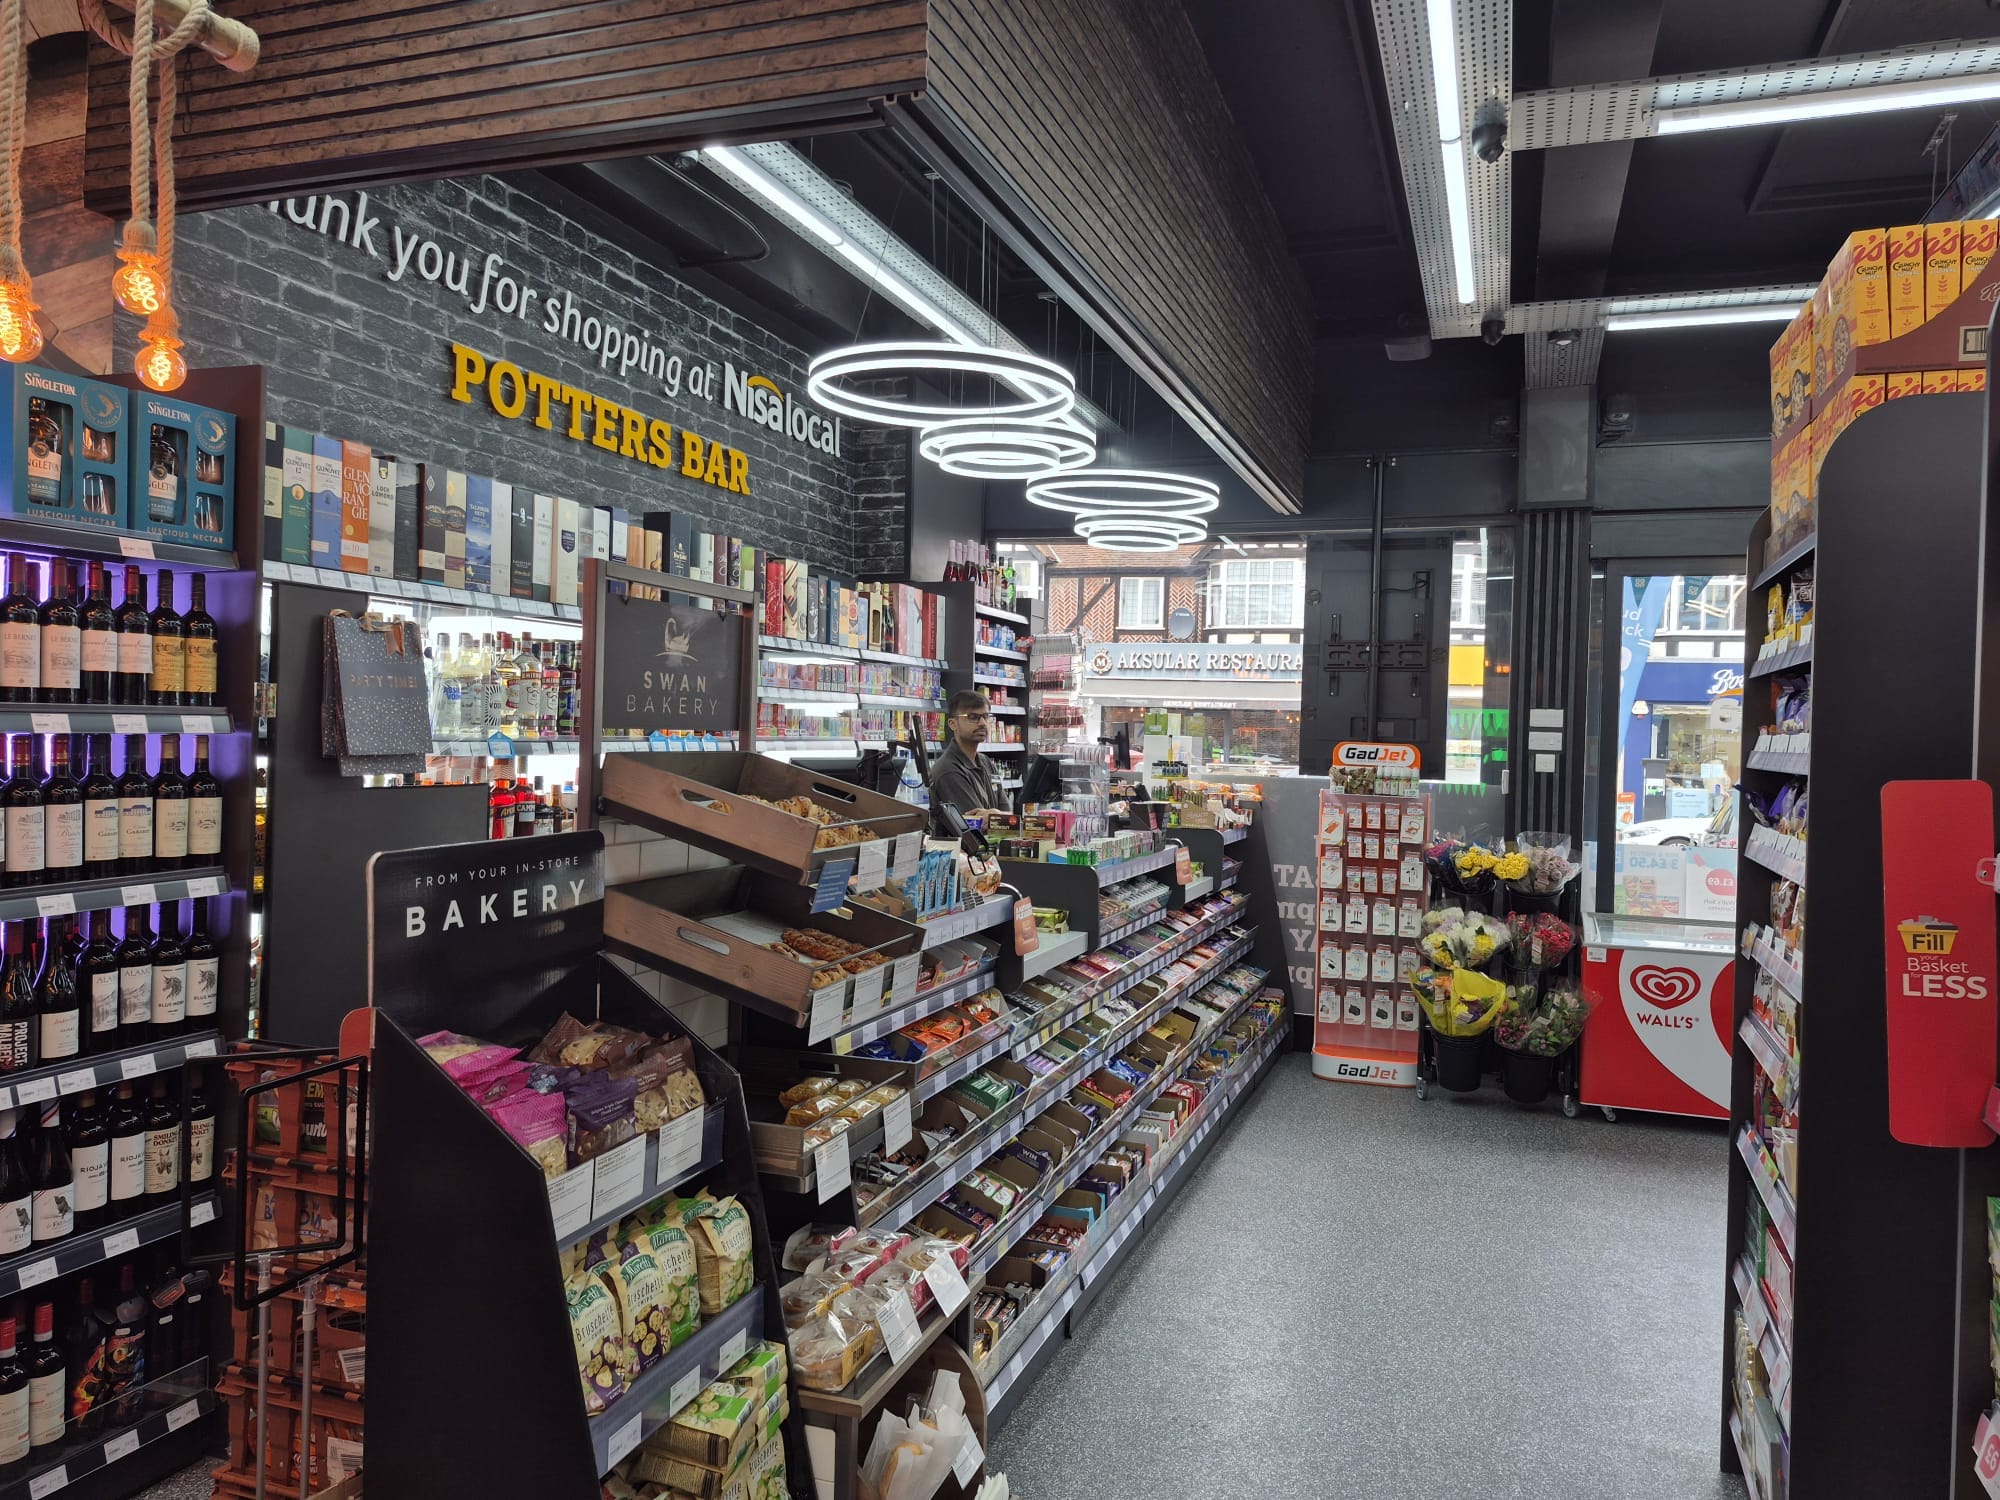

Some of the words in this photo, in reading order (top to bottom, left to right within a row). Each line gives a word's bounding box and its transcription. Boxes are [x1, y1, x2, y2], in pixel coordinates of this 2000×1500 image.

[268, 190, 382, 256] ank
[386, 226, 468, 296] you
[469, 253, 536, 321] for
[543, 290, 683, 398] shopping
[689, 361, 723, 401] at
[24, 372, 78, 396] SINGLETON
[146, 401, 193, 423] SINGLETON
[451, 343, 673, 470] POTTERS
[680, 430, 751, 495] BAR
[315, 465, 341, 477] GLENLIVET
[343, 466, 370, 484] GLEN
[352, 481, 371, 497] MO
[371, 491, 395, 500] LOMOND
[342, 491, 365, 507] RAN
[27, 507, 77, 522] LUSCIOUS
[80, 515, 117, 528] NECTAR
[351, 506, 369, 521] GIE
[146, 526, 190, 539] LUSCIOUS
[192, 533, 224, 544] NECTAR
[1117, 653, 1200, 671] AKSULAR
[1206, 653, 1303, 672] RESTAURA
[643, 671, 707, 692] SWAN
[626, 694, 720, 716] BAKERY
[1345, 747, 1408, 761] GadJet
[415, 873, 459, 889] FROM
[469, 866, 507, 881] YOUR
[516, 855, 580, 874] IN-STORE
[406, 878, 586, 939] BAKERY
[1912, 933, 1944, 951] Fill
[1907, 957, 1969, 975] Basket
[1902, 974, 1988, 1000] LESS
[1636, 1012, 1695, 1030] WALL'S
[1337, 1063, 1399, 1081] GadJet
[1021, 1146, 1038, 1161] WIN
[575, 1305, 615, 1342] Bruschette
